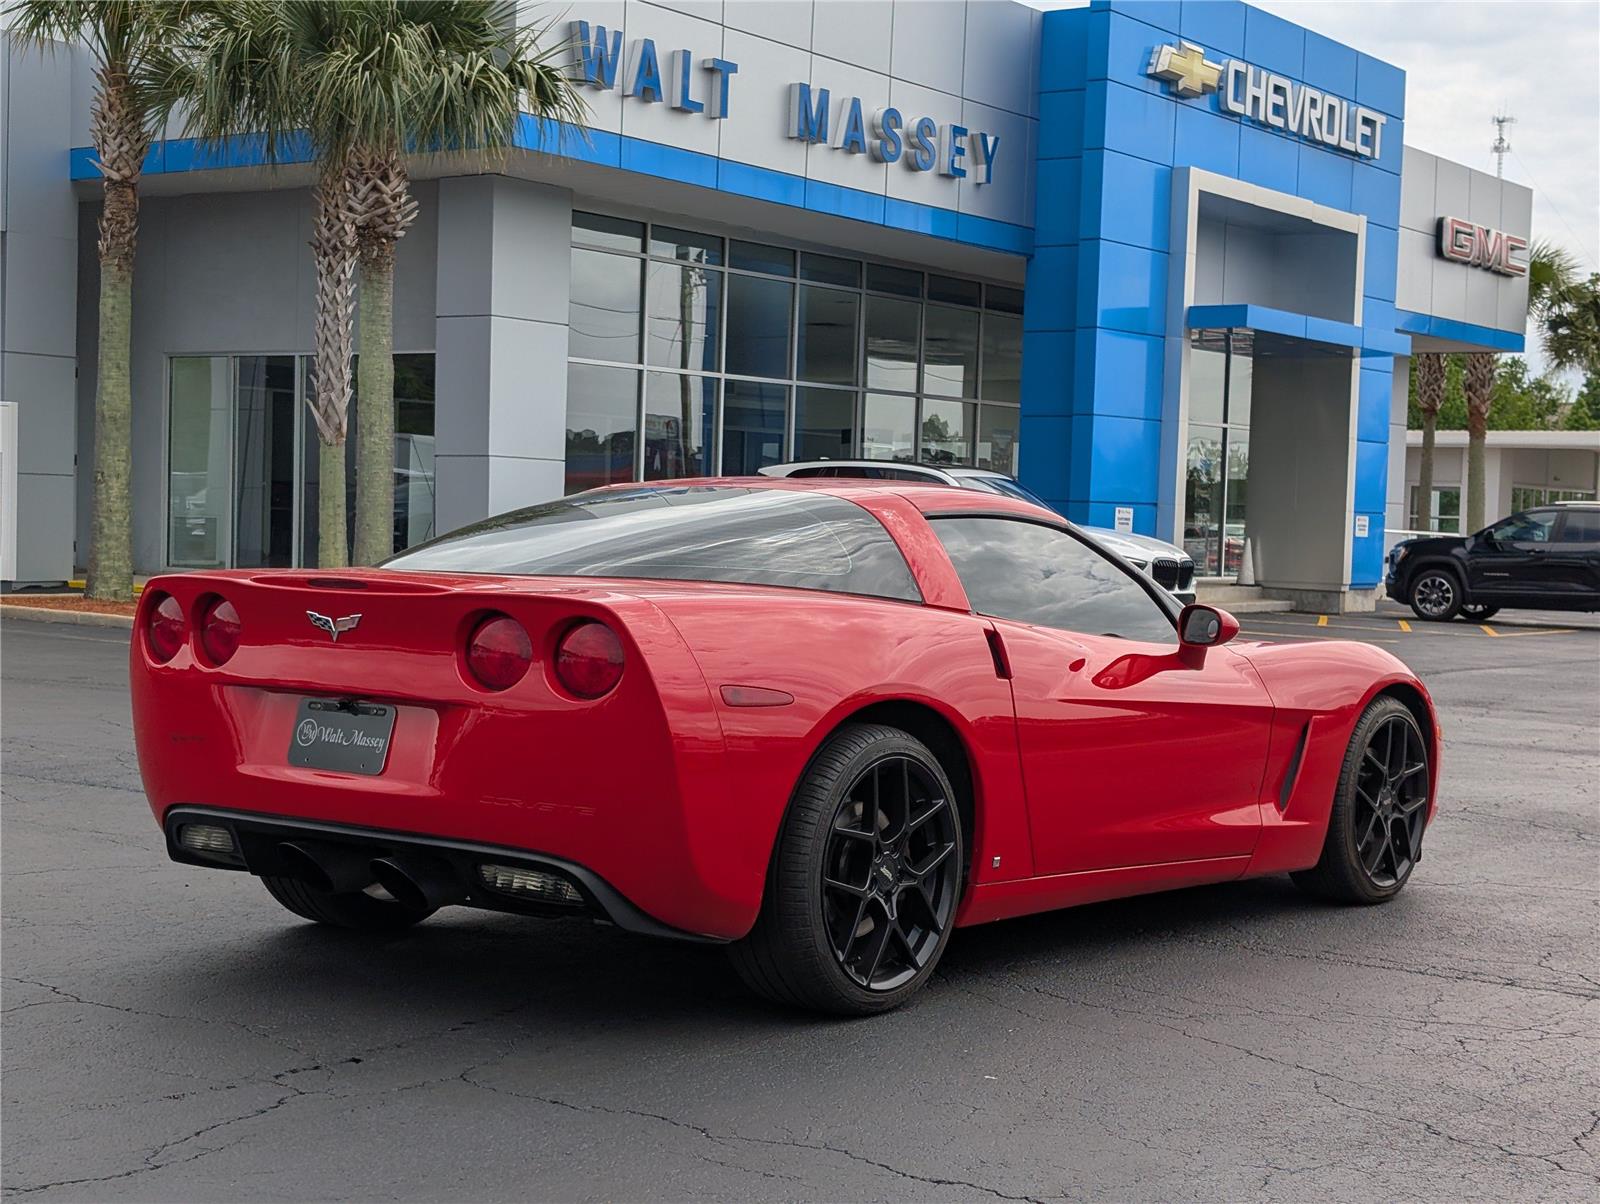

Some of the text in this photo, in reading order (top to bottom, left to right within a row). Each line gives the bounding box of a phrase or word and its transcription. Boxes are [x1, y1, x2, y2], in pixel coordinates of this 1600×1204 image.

[569, 20, 1000, 185] WALT MASSEY
[1222, 58, 1387, 160] CHEVROLET
[1438, 216, 1528, 277] GMC
[317, 726, 386, 754] Walt Massey
